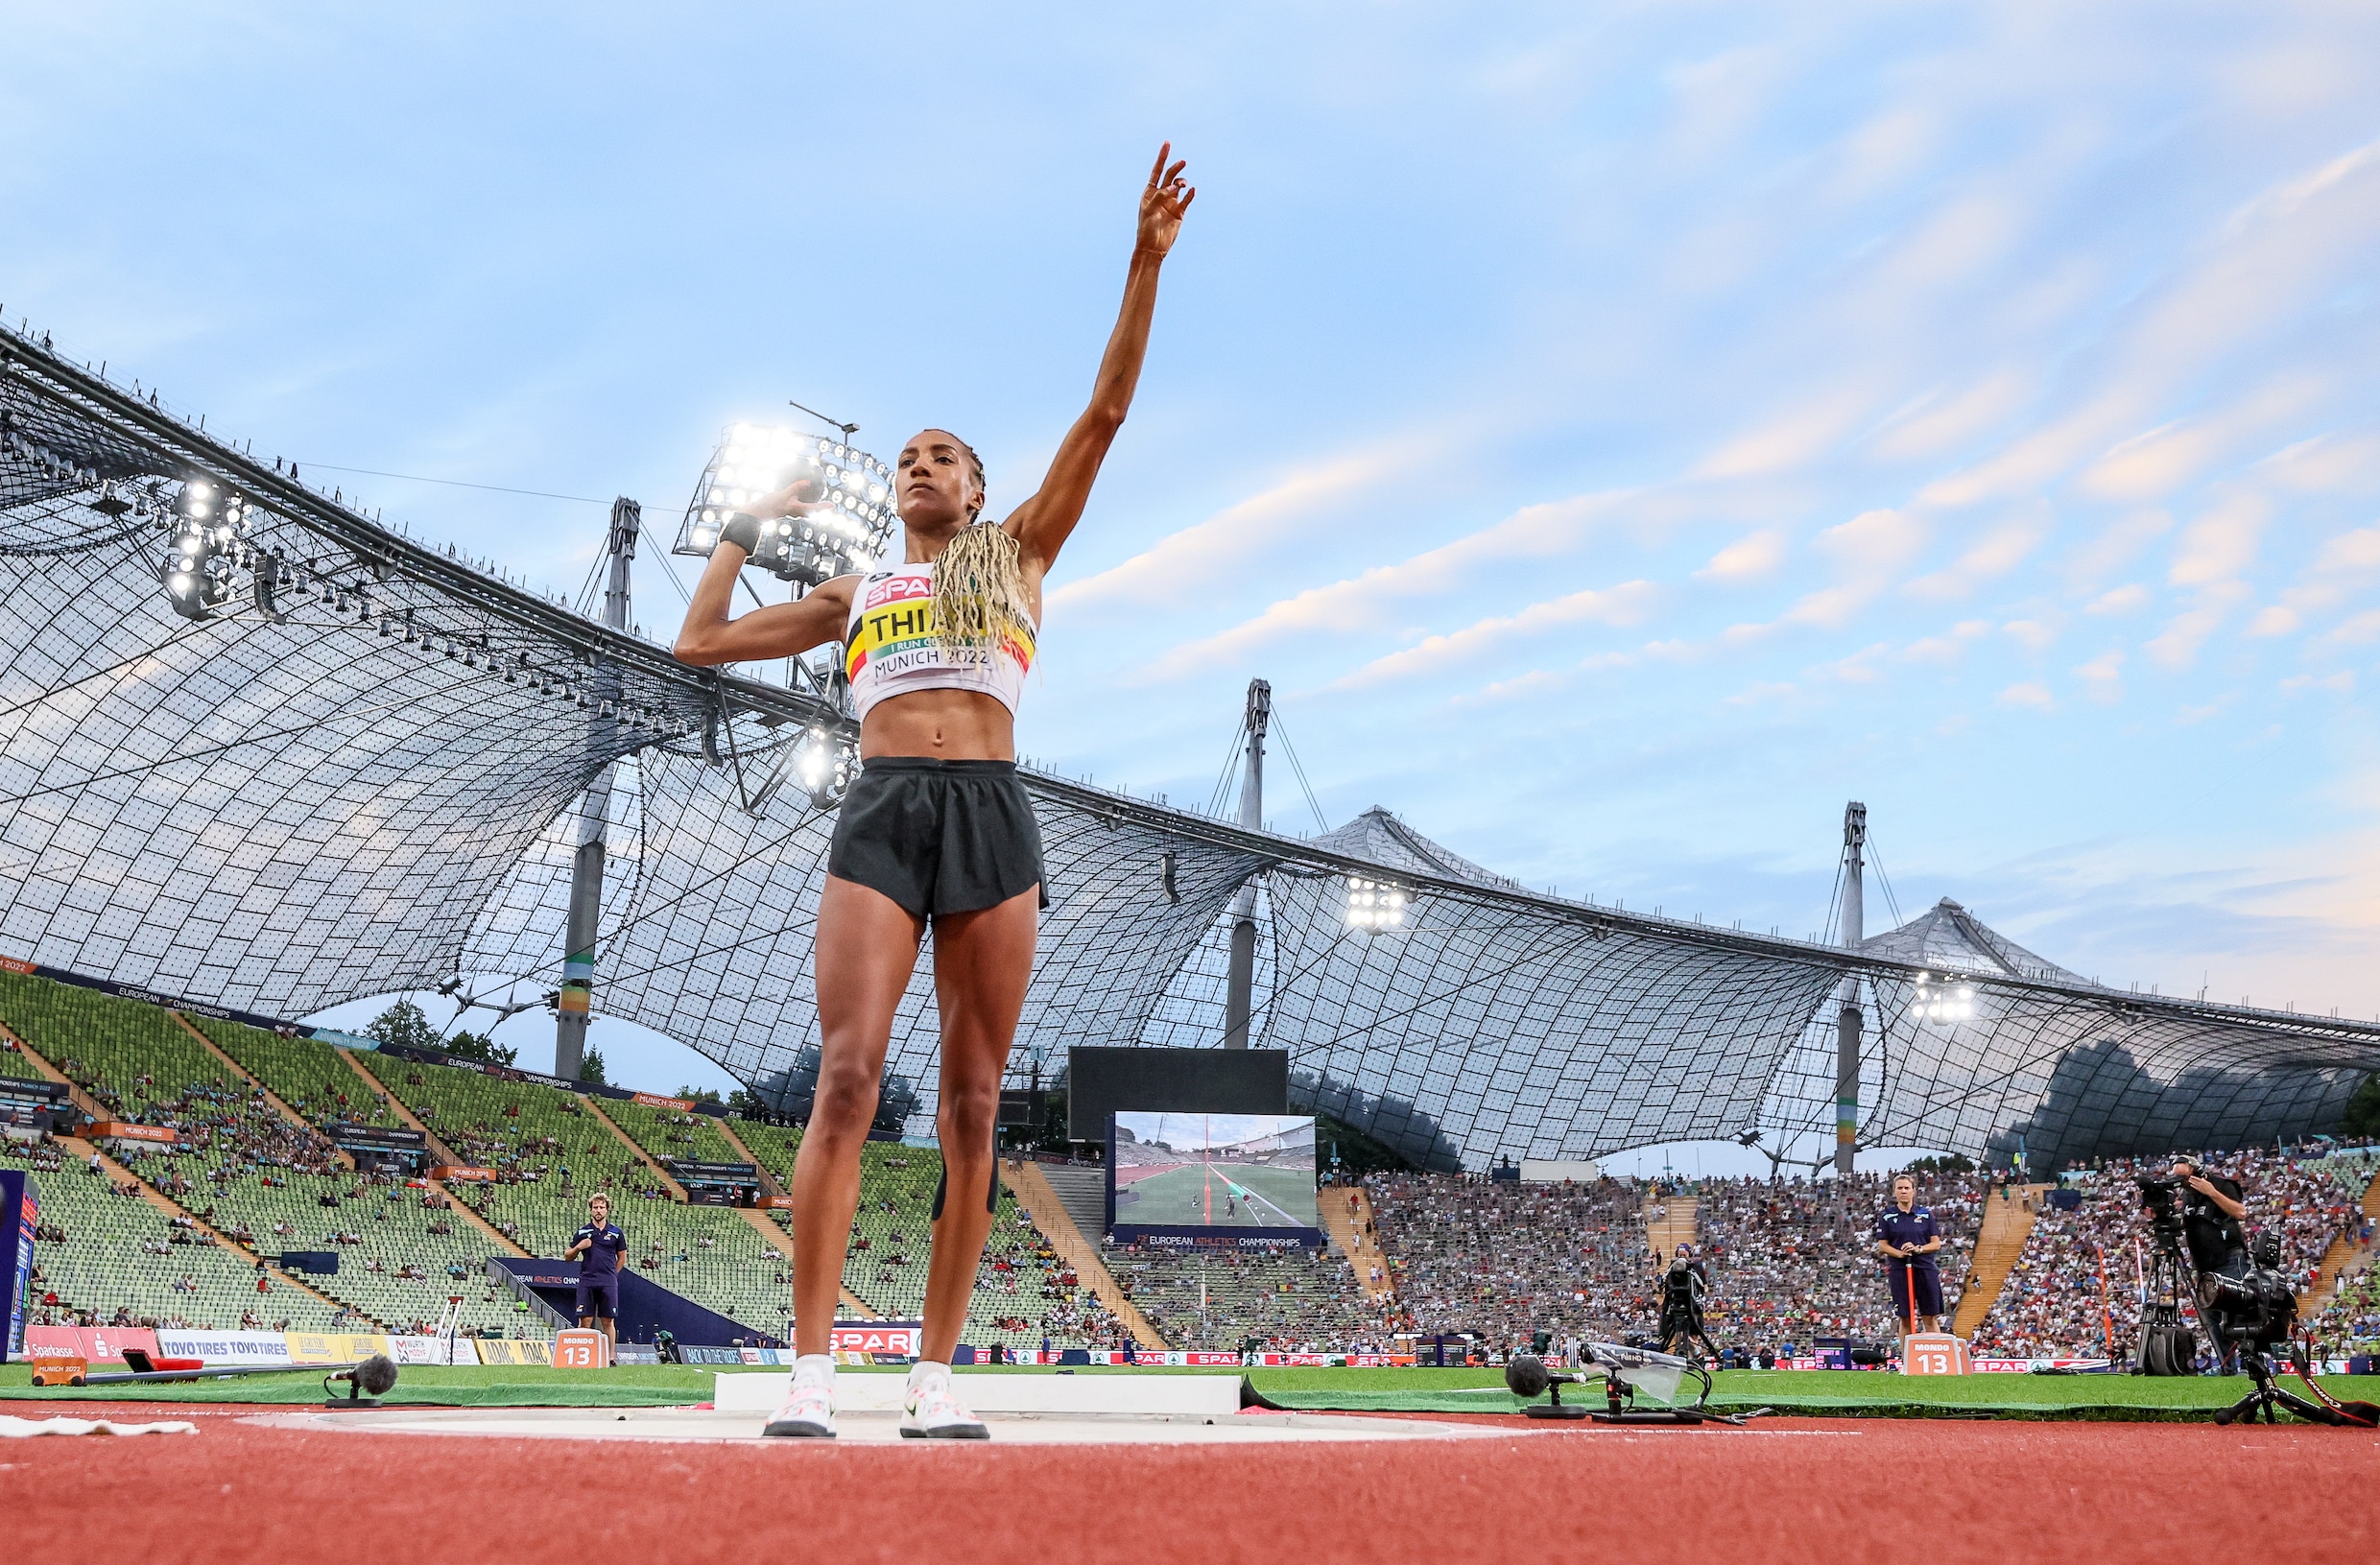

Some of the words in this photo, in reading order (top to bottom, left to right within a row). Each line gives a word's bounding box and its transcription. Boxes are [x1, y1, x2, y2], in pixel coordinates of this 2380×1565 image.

[867, 579, 939, 606] SPA
[896, 640, 921, 652] RUN
[875, 651, 939, 677] MUNICH
[6, 960, 26, 971] 2022
[118, 986, 160, 1004] EUROPEAN
[173, 999, 231, 1019] CHAMPIONSHIPS
[1035, 1048, 1040, 1058] 1
[447, 1057, 485, 1072] EUROPEAN
[525, 1074, 573, 1088] HAMPIONSHIPS
[638, 1094, 667, 1105] MUNICH
[668, 1100, 686, 1110] 2022
[125, 1126, 148, 1136] MUNICH
[148, 1128, 163, 1137] 2022
[454, 1169, 476, 1177] MUNICH
[1150, 1235, 1193, 1245] EUROPEAN
[1196, 1237, 1237, 1245] ATHLETICS
[1238, 1238, 1301, 1246] CHAMPIONSHIPS
[534, 1275, 562, 1284] ATHLETICS
[32, 1343, 75, 1358] Sparkasse
[165, 1341, 196, 1355] TOYO
[197, 1342, 228, 1355] TIRES
[229, 1340, 259, 1354] TOYO
[259, 1342, 288, 1355] TIRES
[485, 1341, 514, 1364] ADAC
[520, 1341, 548, 1364] ADAC
[1915, 1343, 1950, 1352] MONDO
[564, 1346, 590, 1365] 13
[1135, 1354, 1165, 1363] PAR
[1916, 1354, 1948, 1373] 13
[1974, 1361, 2027, 1372] SPAR
